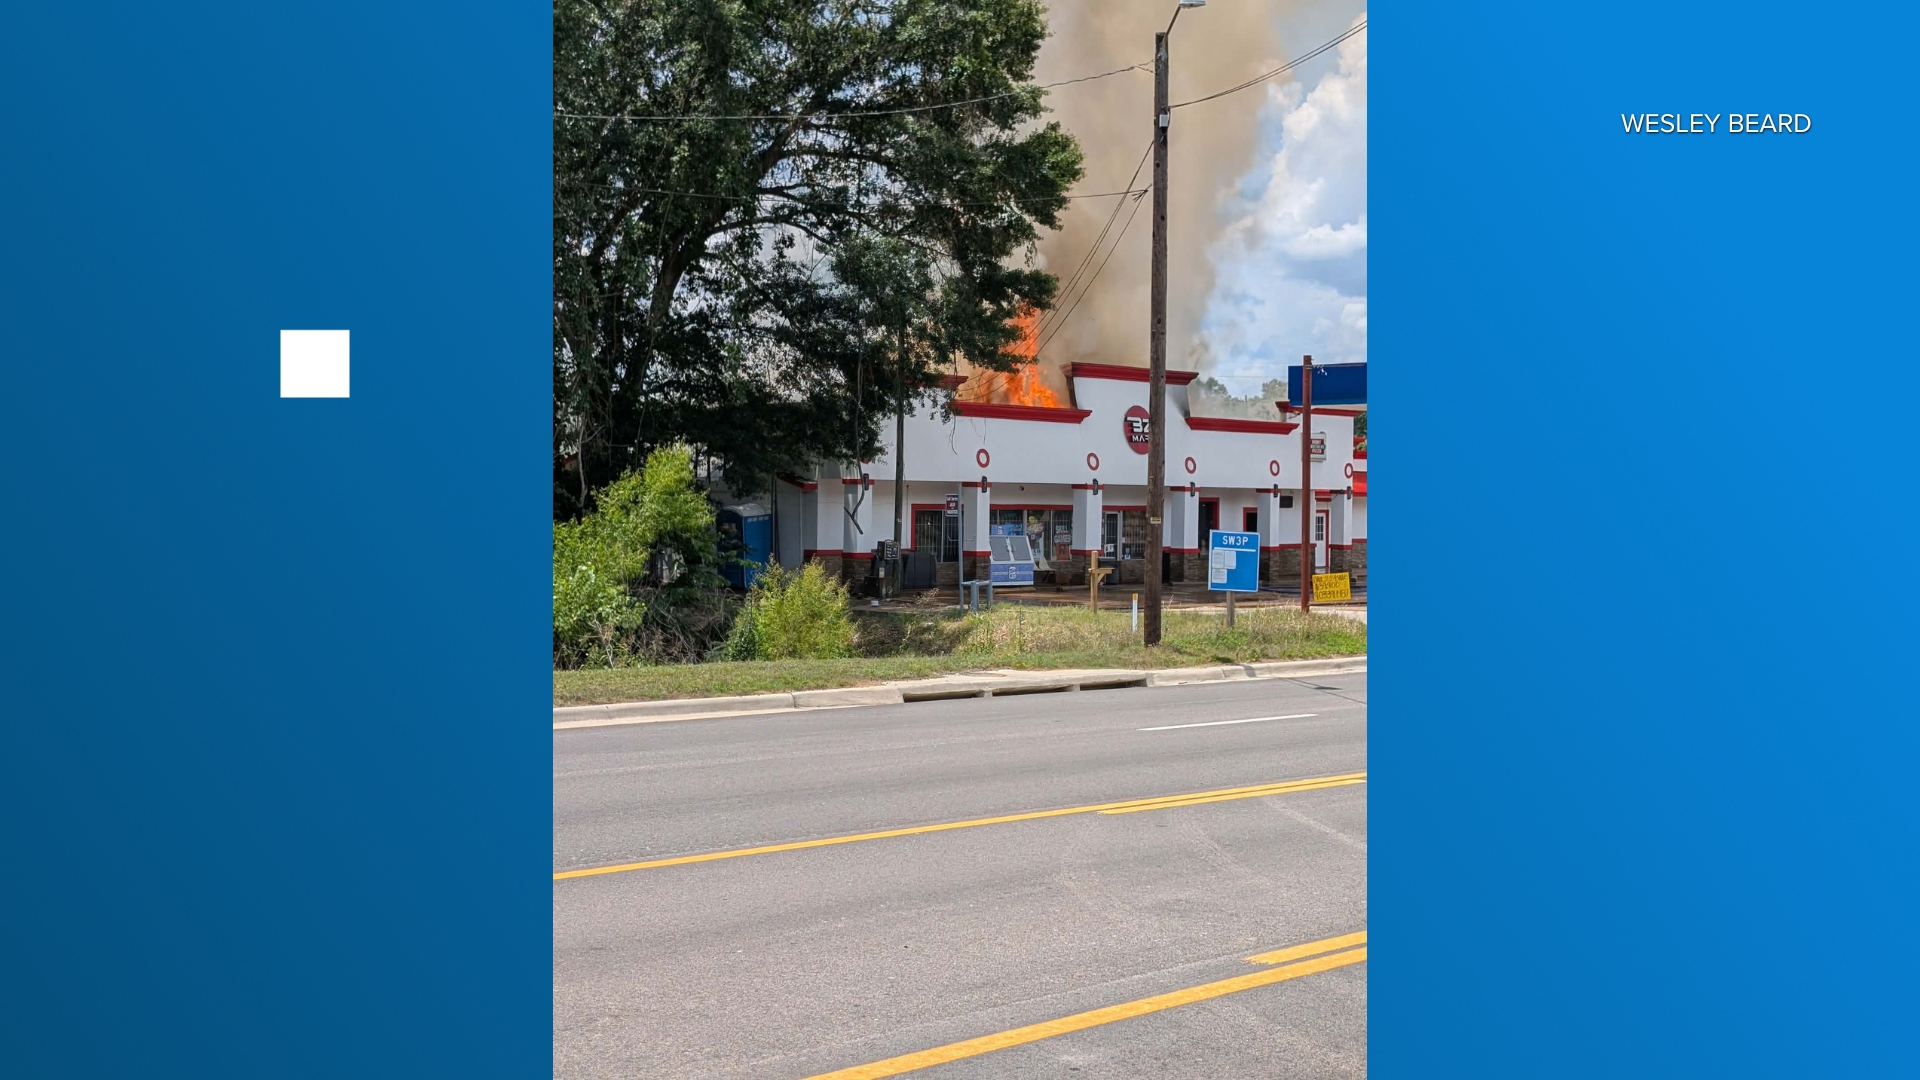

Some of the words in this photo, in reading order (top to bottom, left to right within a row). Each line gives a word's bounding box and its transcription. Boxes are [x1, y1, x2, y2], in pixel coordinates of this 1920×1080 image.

[1055, 525, 1069, 534] SKILL
[1054, 534, 1072, 543] GAMES
[1222, 535, 1249, 546] SW3P
